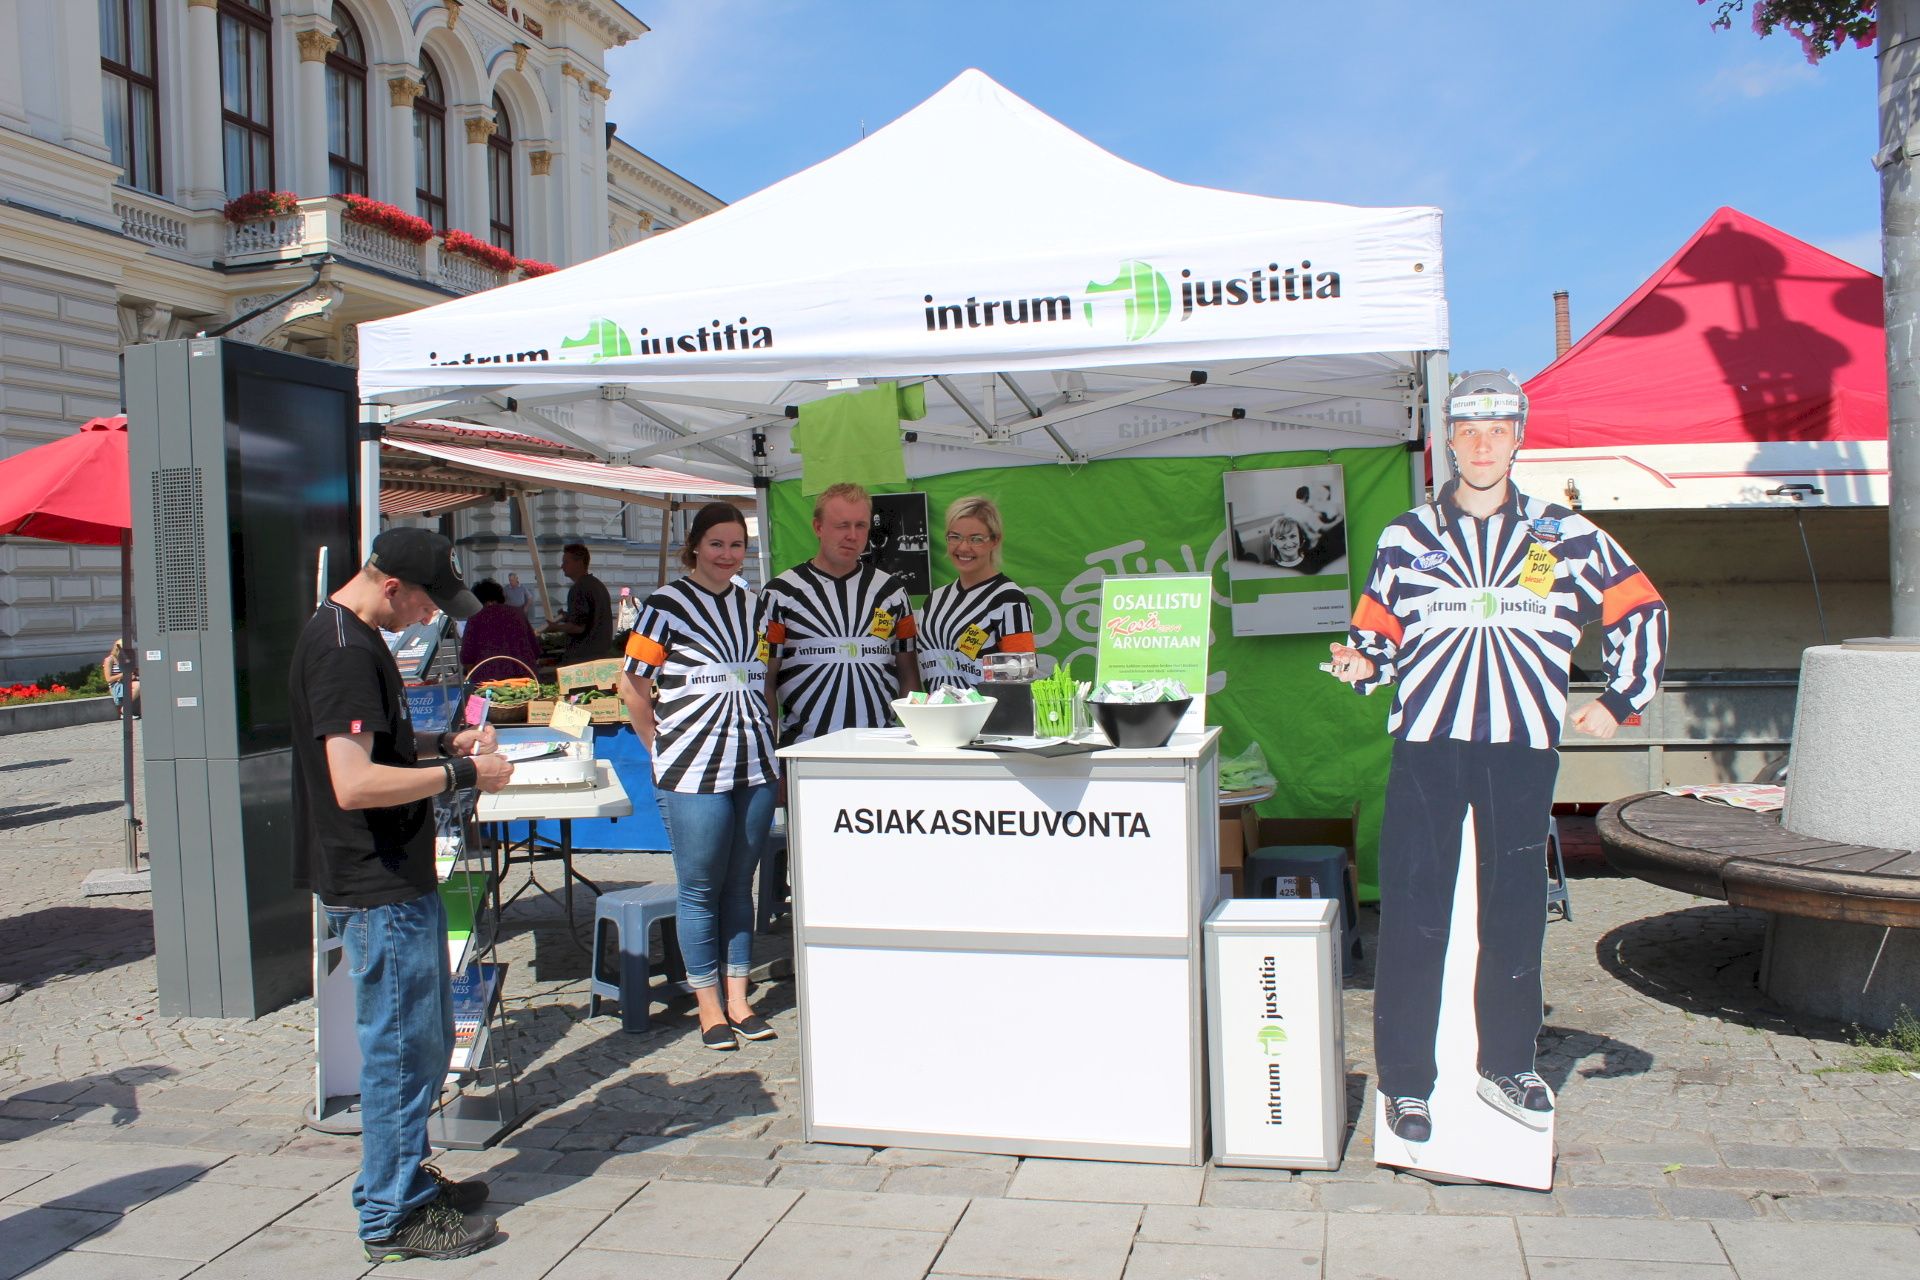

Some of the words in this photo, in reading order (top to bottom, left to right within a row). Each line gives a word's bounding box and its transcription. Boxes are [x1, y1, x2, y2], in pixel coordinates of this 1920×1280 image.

[924, 294, 1072, 332] intrum
[1180, 260, 1341, 322] justitia
[1528, 550, 1547, 562] Fair
[1112, 593, 1202, 610] OSALLISTU
[1500, 597, 1547, 616] justitia
[874, 611, 886, 619] Fair
[965, 627, 980, 636] Fair
[1106, 611, 1159, 639] Kesä
[798, 645, 836, 656] intrum
[1112, 635, 1201, 649] ARVONTAAN
[955, 657, 982, 677] jstitia
[691, 674, 727, 684] intrum
[748, 669, 767, 684] just
[832, 809, 1151, 838] ASIAKASNEUVONTA
[1260, 955, 1283, 1020] justitia
[1266, 1062, 1282, 1126] intrum
